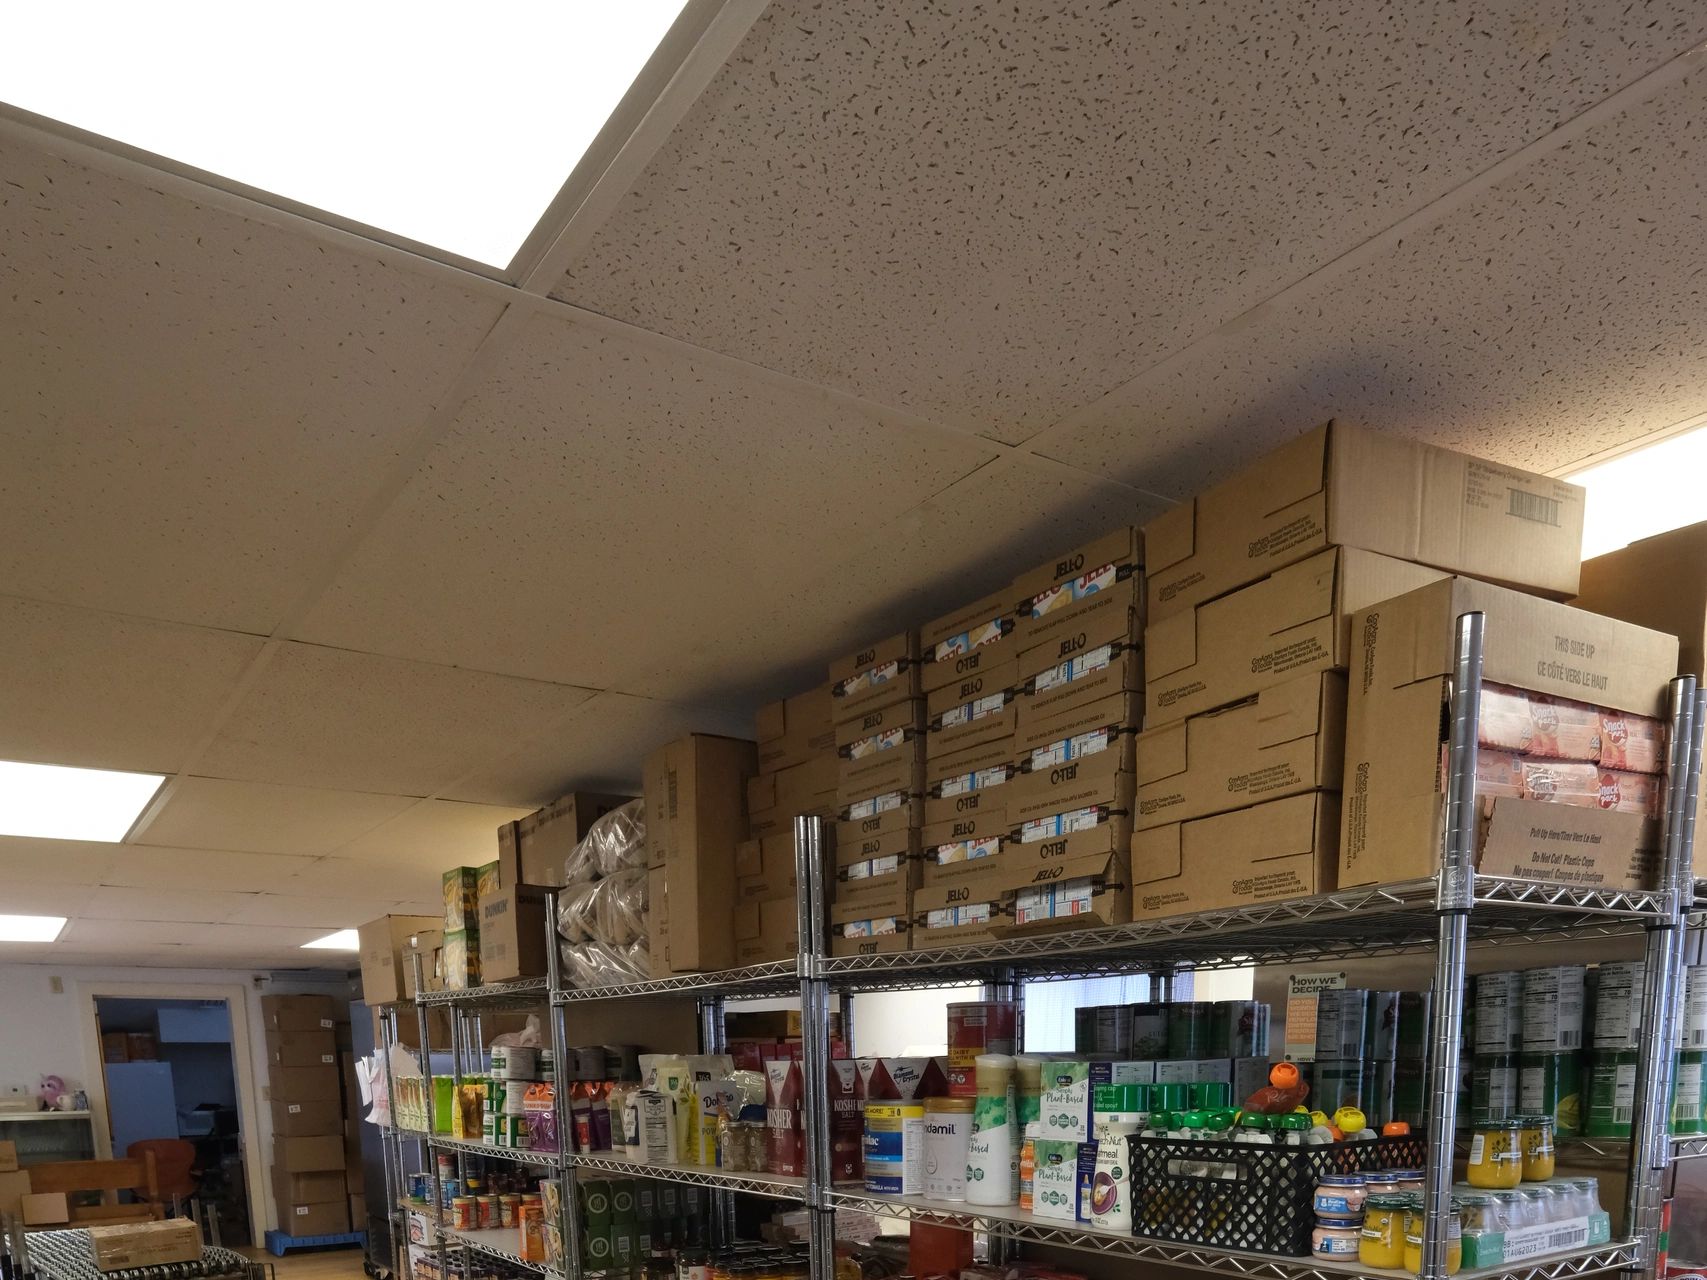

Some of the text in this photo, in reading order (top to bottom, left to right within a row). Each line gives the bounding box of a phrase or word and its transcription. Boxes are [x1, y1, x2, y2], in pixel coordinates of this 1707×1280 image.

[1554, 636, 1595, 659] THIS SIDE UP
[1537, 661, 1608, 691] CE CÔTÉ VERS LE HAUT
[1603, 719, 1626, 734] Snack
[1530, 828, 1540, 838] Pull
[1540, 830, 1547, 840] Up
[1584, 834, 1590, 842] Le
[1532, 852, 1595, 867] Do Not Cut! Plastic Cups
[1514, 865, 1521, 876] Ne
[1522, 868, 1532, 879] pas
[1573, 871, 1580, 880] de
[1580, 872, 1604, 884] plastique
[1293, 977, 1337, 986] HOW WE
[1046, 1092, 1083, 1104] Plant-Based
[773, 1129, 785, 1138] SALT
